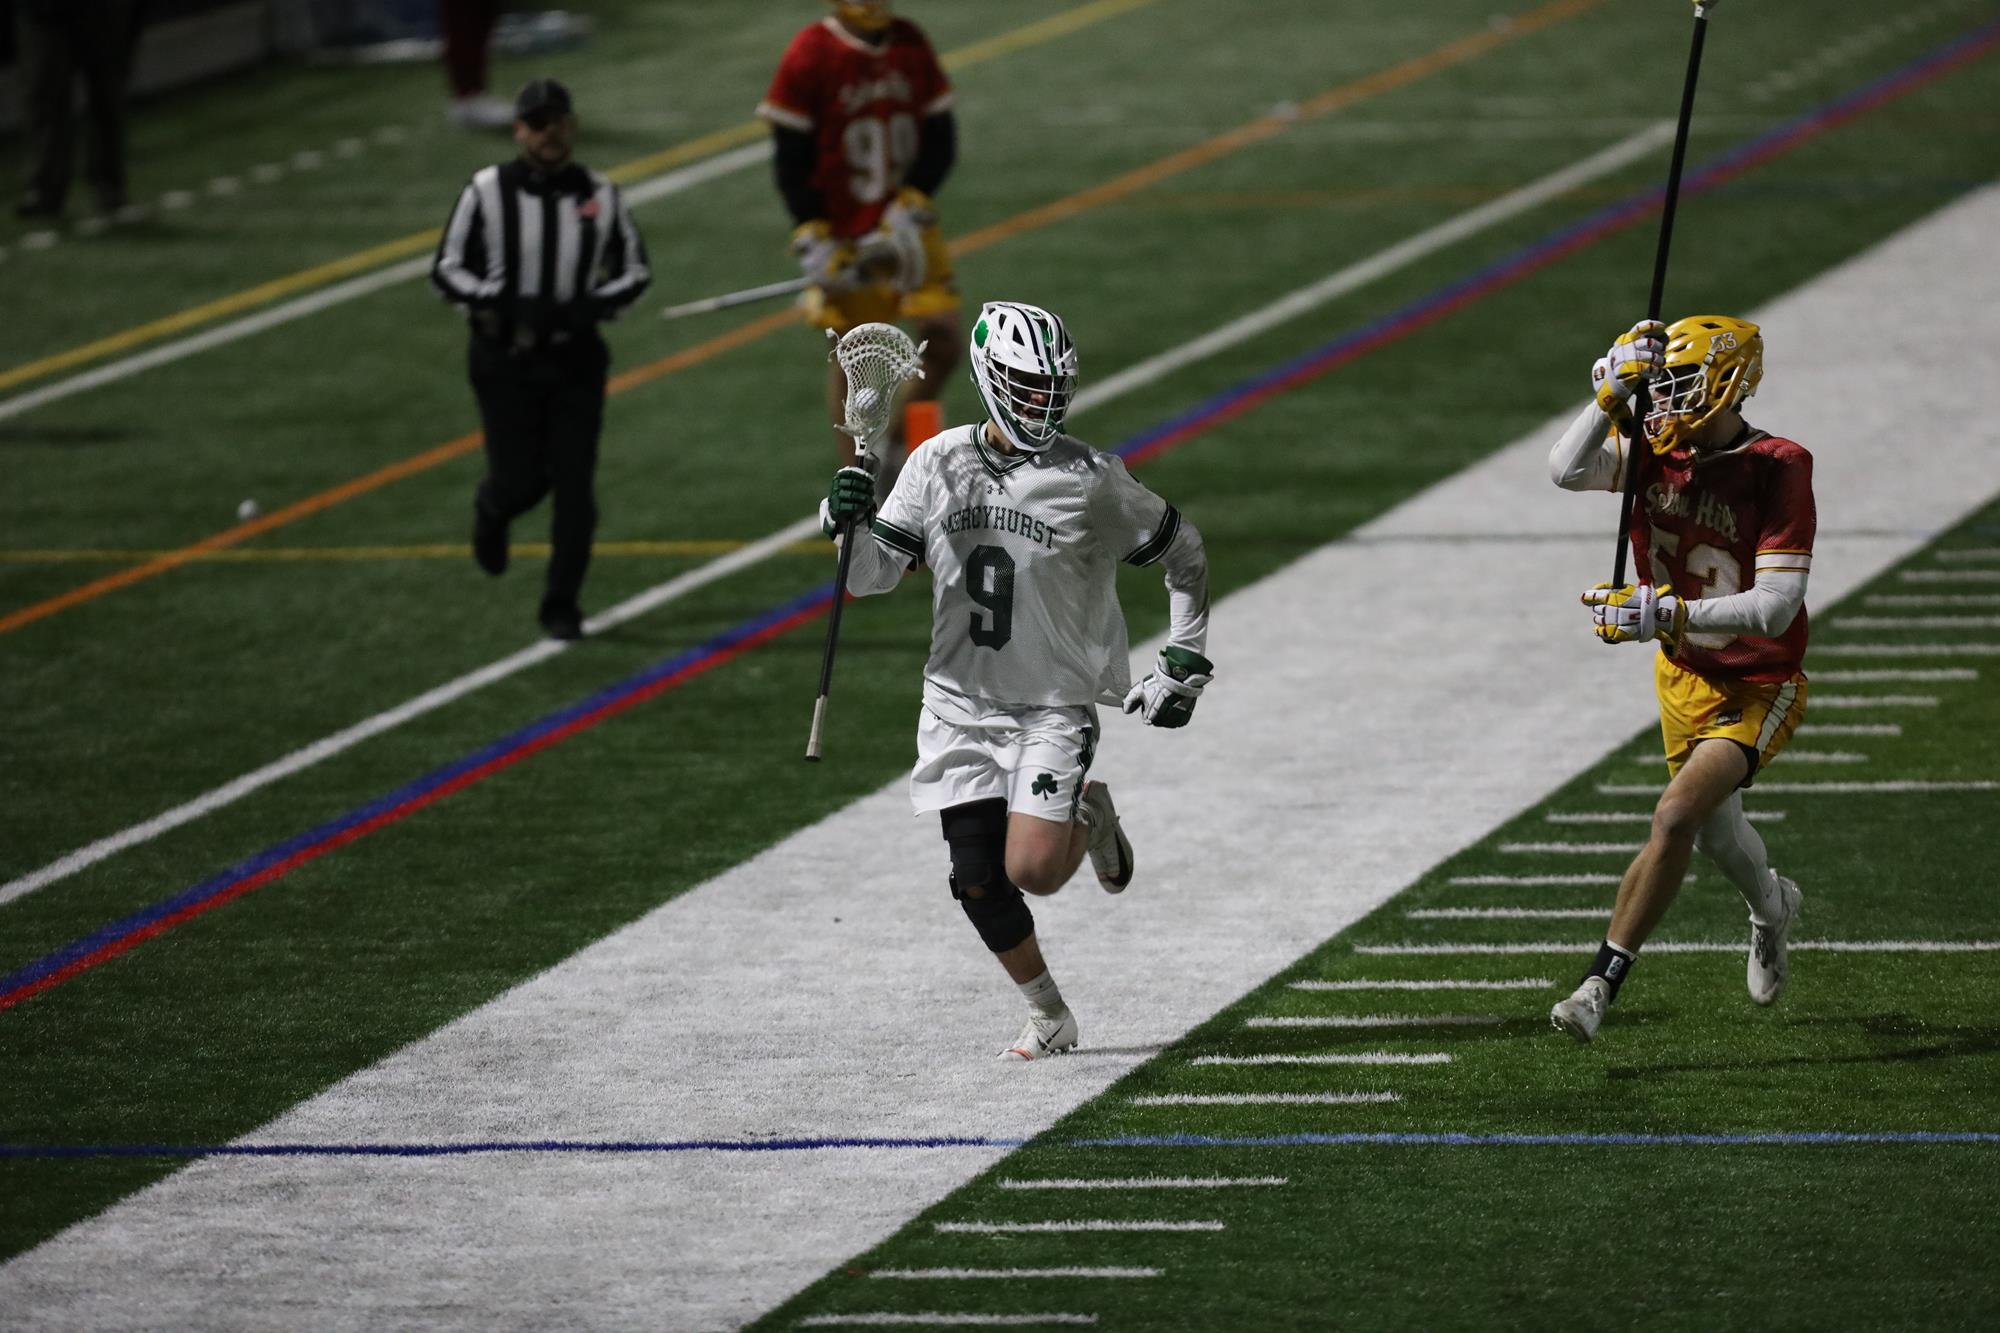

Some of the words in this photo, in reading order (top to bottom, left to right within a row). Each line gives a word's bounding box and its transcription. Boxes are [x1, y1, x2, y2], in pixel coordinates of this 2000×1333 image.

[1710, 332, 1737, 352] 53
[941, 505, 1057, 549] MERCYHURST
[966, 544, 1015, 651] 9
